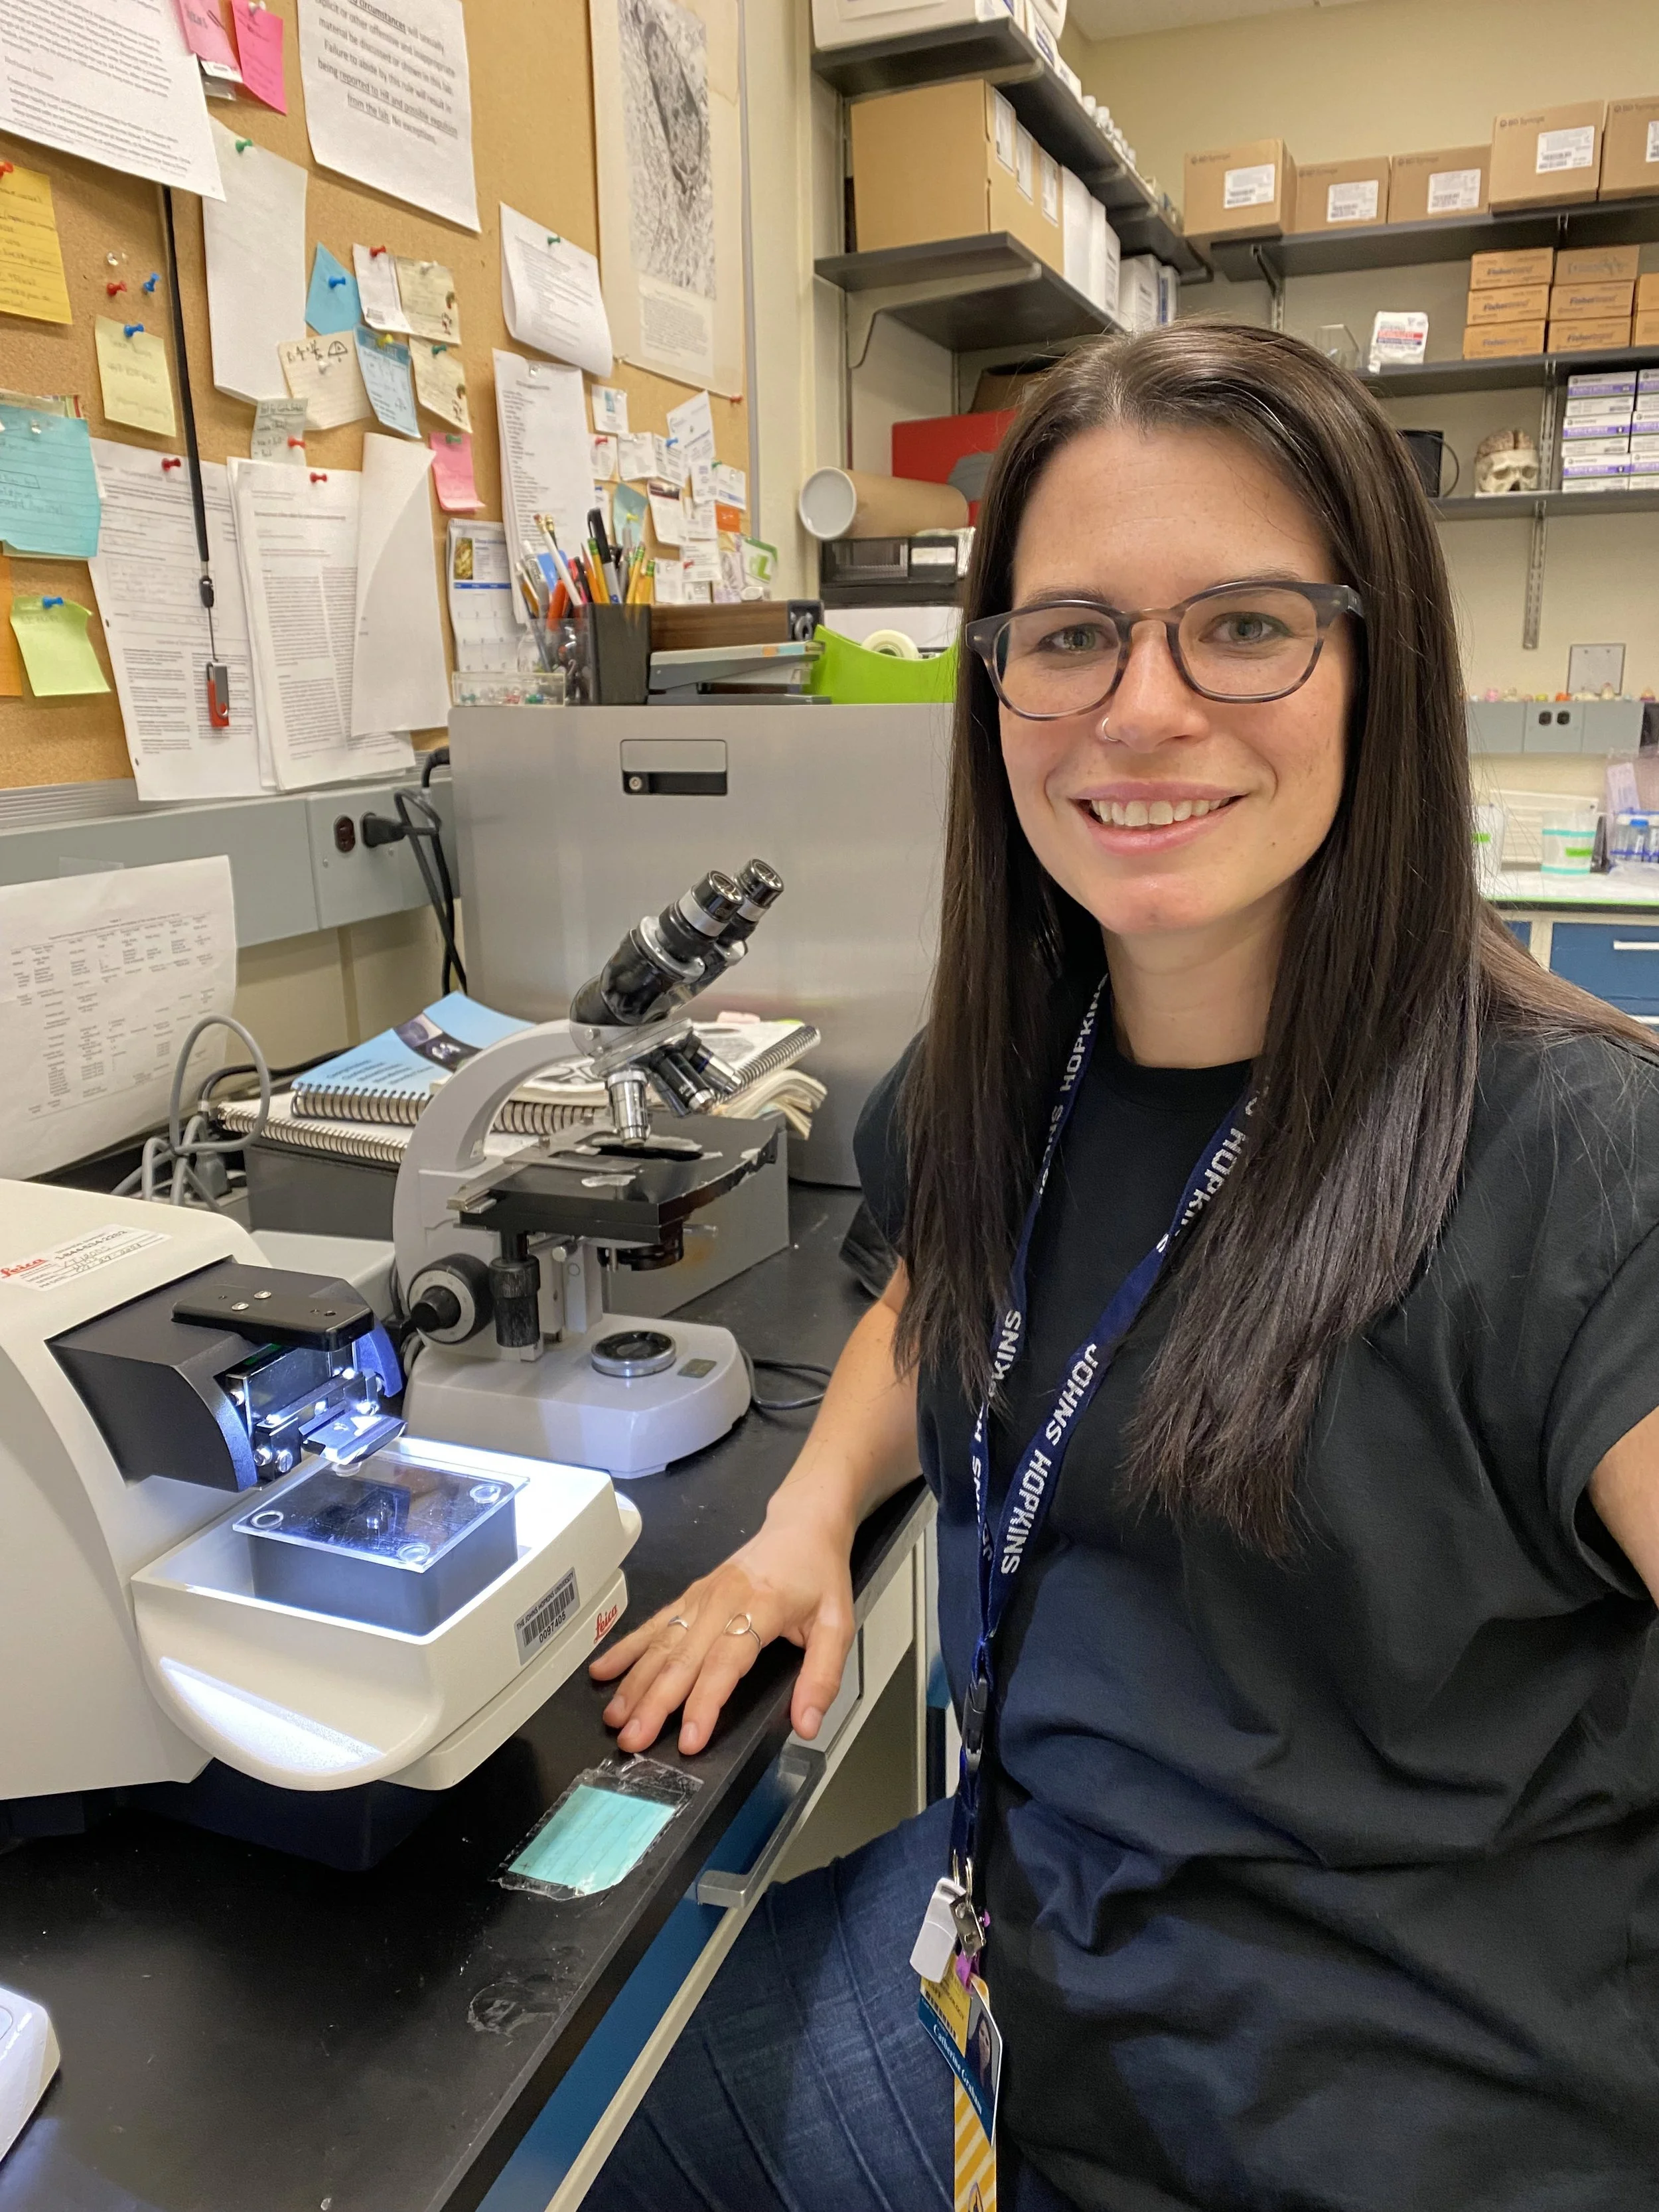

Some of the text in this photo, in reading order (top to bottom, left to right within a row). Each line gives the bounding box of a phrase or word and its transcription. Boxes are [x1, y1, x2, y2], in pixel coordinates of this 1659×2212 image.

[319, 18, 348, 40] material
[349, 31, 358, 45] be
[340, 8, 347, 19] or
[349, 13, 368, 30] other
[359, 0, 406, 35] circumstances
[324, 38, 348, 61] Failure
[350, 53, 357, 65] to
[358, 58, 378, 75] abide
[378, 66, 387, 82] by
[318, 57, 338, 79] being
[339, 71, 370, 94] reported
[371, 85, 379, 98] to
[380, 88, 390, 102] HR
[392, 96, 403, 110] and
[403, 102, 429, 123] possible
[347, 90, 364, 111] from
[366, 102, 377, 117] the
[1060, 973, 1108, 1092] HOPKI
[1, 1258, 50, 1279] Leica
[1045, 1343, 1099, 1446] JOHNS
[1001, 1449, 1052, 1575] HOPKINS
[516, 1572, 574, 1631] THE JOHNS HOPKINS UNIVERSITY
[539, 1613, 566, 1643] 0097405
[593, 1604, 618, 1645] Leica
[933, 2024, 961, 2071] Catherine
[962, 2068, 983, 2115] Graham
